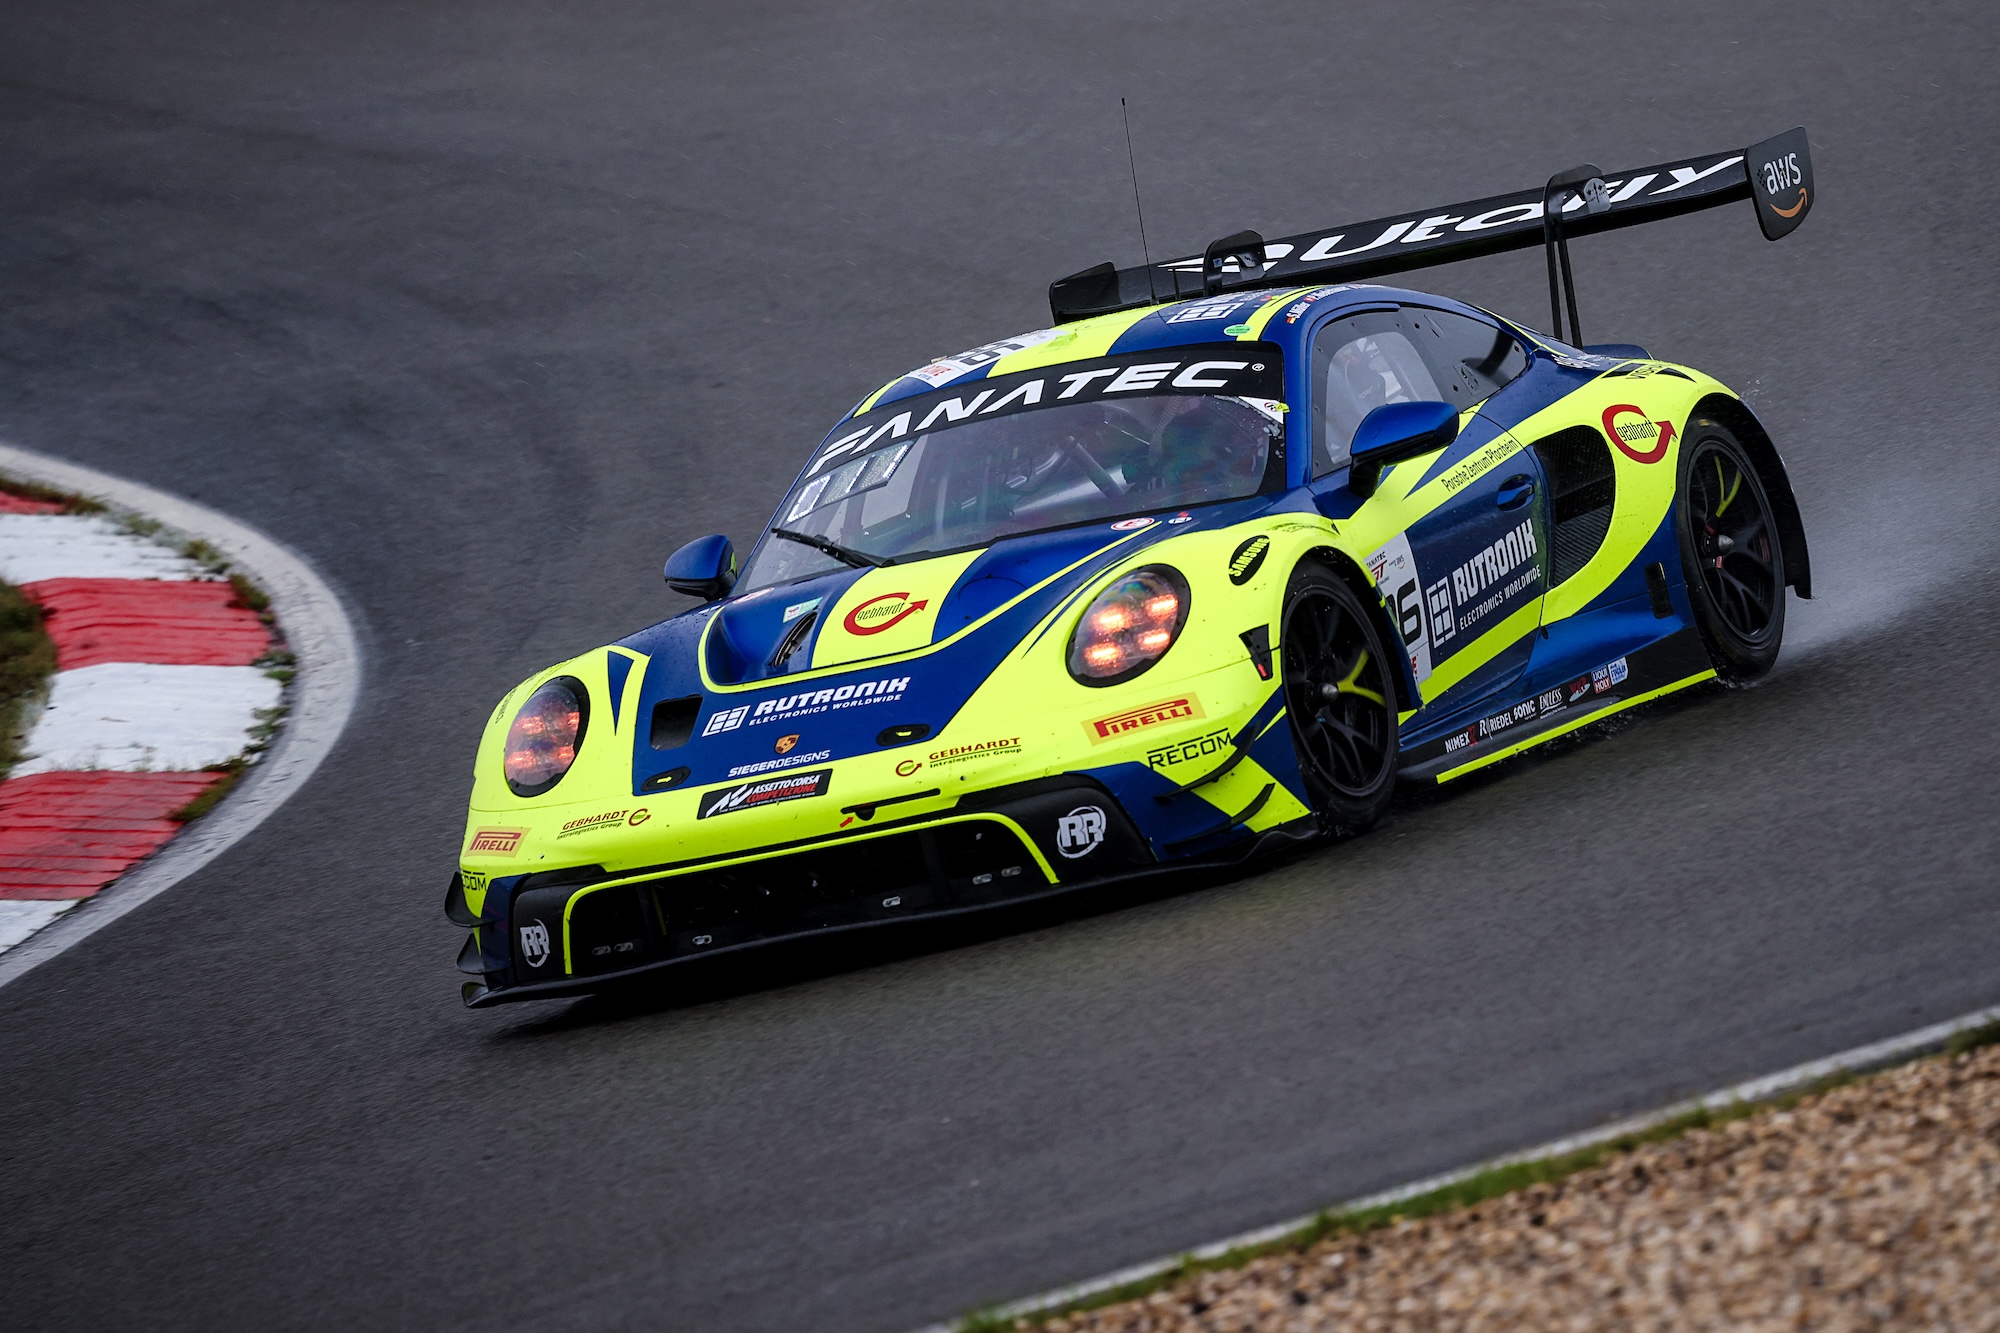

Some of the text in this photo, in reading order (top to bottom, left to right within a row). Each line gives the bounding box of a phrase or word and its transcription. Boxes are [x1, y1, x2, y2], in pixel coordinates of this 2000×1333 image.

[1763, 152, 1802, 195] aws
[804, 360, 1250, 480] FANATEC
[1616, 419, 1658, 442] gebhardt
[1441, 439, 1519, 492] Porsche Zentrum Pforzheim
[1229, 537, 1270, 577] SAMSUNG
[1452, 518, 1538, 607] RUTRONIK
[1459, 564, 1541, 630] ELECTRONICS WORLDWIDE
[857, 602, 905, 621] gebhardt
[749, 694, 902, 726] ELECTRONICS WORLDWIDE
[754, 676, 911, 717] RUTRONIK
[1093, 699, 1193, 738] PIRELLI
[1490, 713, 1513, 733] RIEDEL
[929, 737, 1020, 760] GEBHARDT
[930, 748, 1022, 768] Intralogistics Group
[1146, 728, 1233, 770] RECOM
[728, 750, 831, 777] SIEGERDESIGNS
[746, 783, 817, 803] COMPETIZIONE
[752, 774, 821, 794] ASSETTO CORSA
[556, 822, 623, 840] Intralogistics Group
[562, 809, 630, 831] GEBHARDT
[470, 831, 522, 852] PIRELLI
